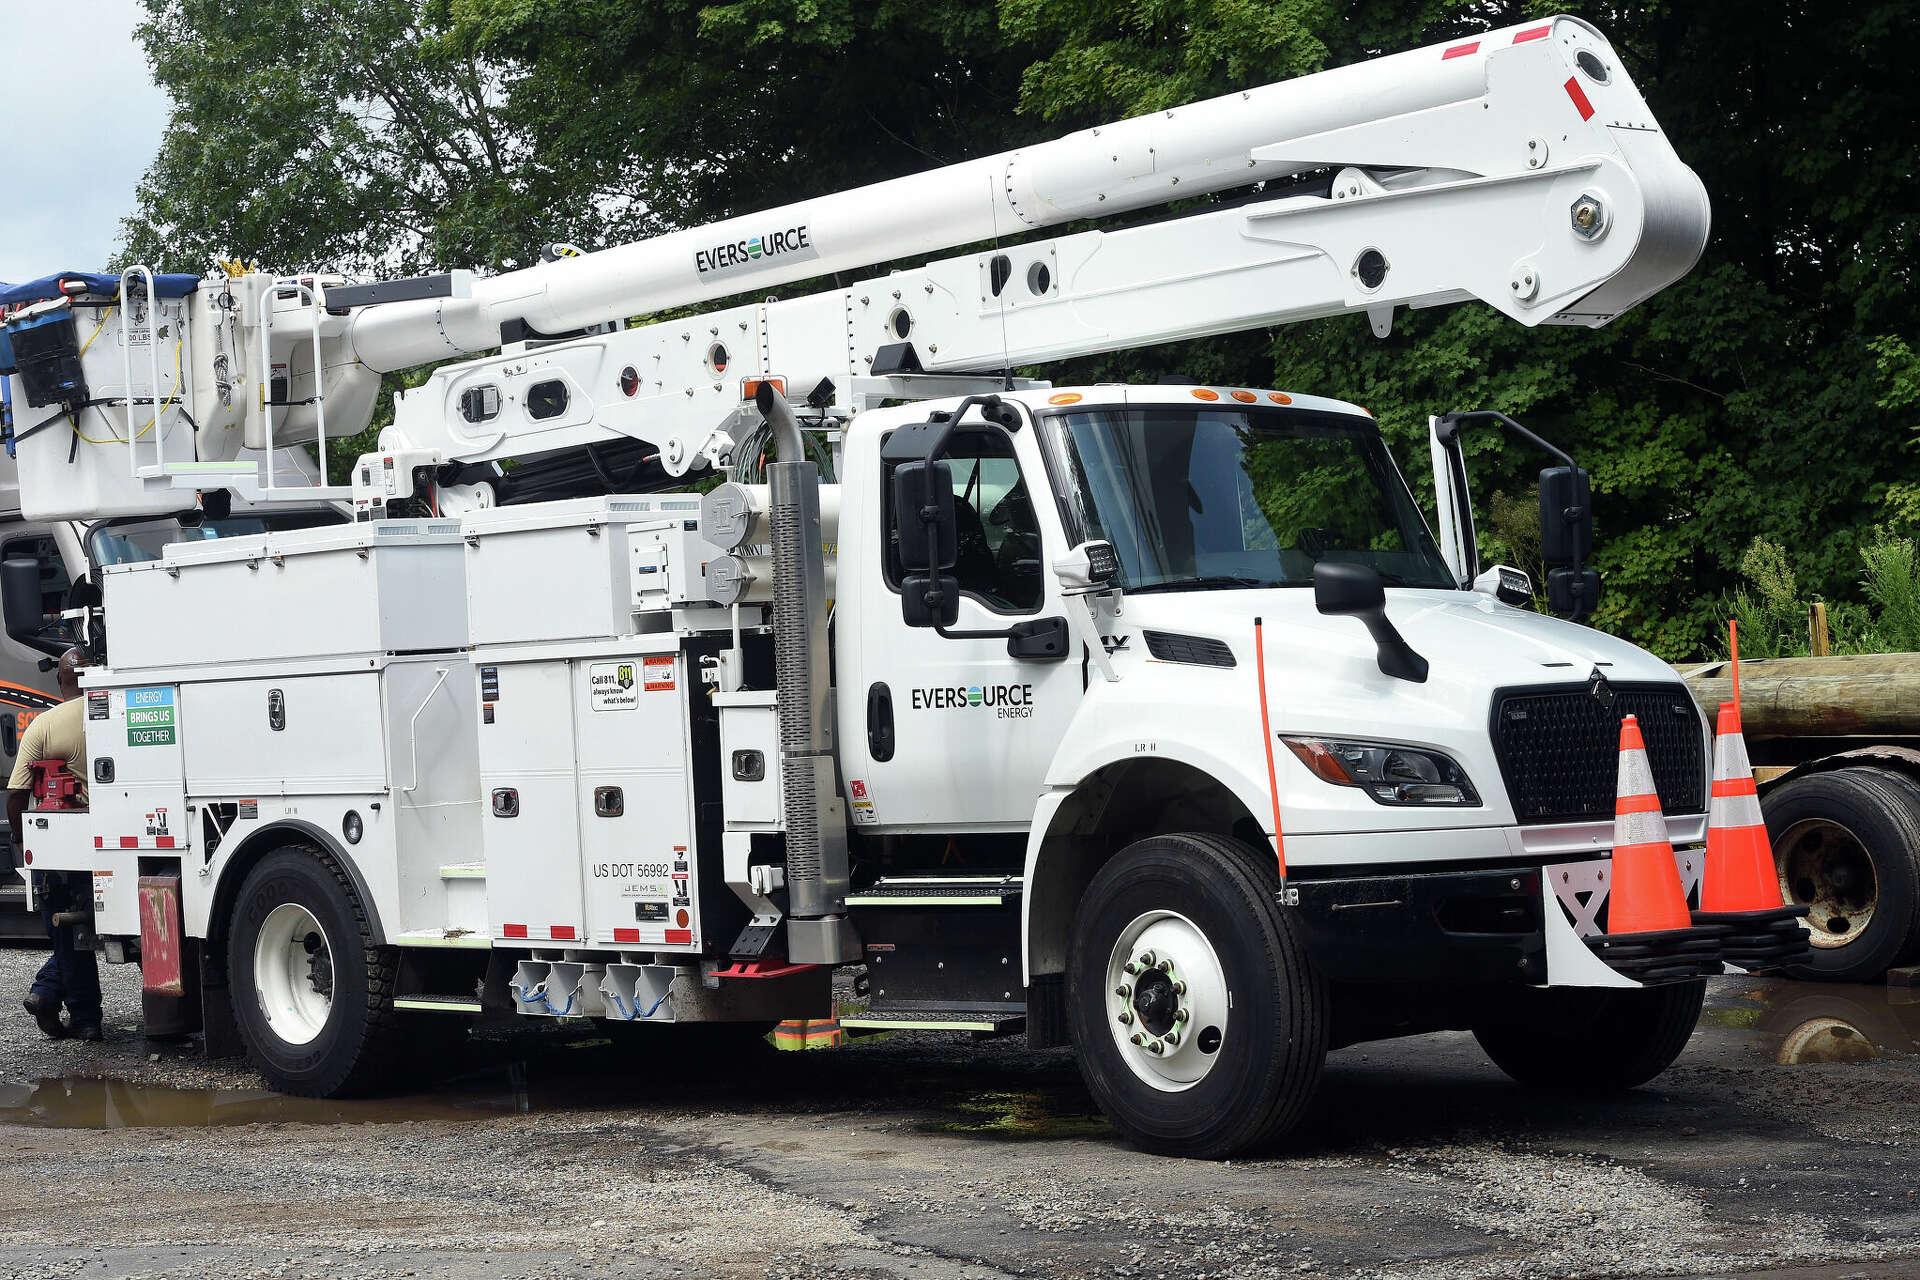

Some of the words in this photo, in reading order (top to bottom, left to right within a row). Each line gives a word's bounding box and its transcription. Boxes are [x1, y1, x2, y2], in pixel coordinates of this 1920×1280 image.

[696, 225, 810, 273] EVERSOURCE
[619, 666, 632, 680] 811
[591, 675, 604, 685] Call
[604, 675, 617, 685] 811,
[135, 690, 163, 704] ENERGY
[593, 688, 610, 696] always
[610, 687, 624, 695] know
[911, 684, 1033, 710] EVERSOURCE
[603, 697, 620, 705] what's
[130, 711, 158, 724] BRINGS
[159, 710, 170, 722] US
[997, 707, 1034, 719] ENERGY
[132, 730, 170, 743] TOGETHER
[593, 863, 609, 878] US
[611, 863, 634, 878] DOT
[637, 863, 669, 878] 56992
[624, 884, 658, 892] JEMS
